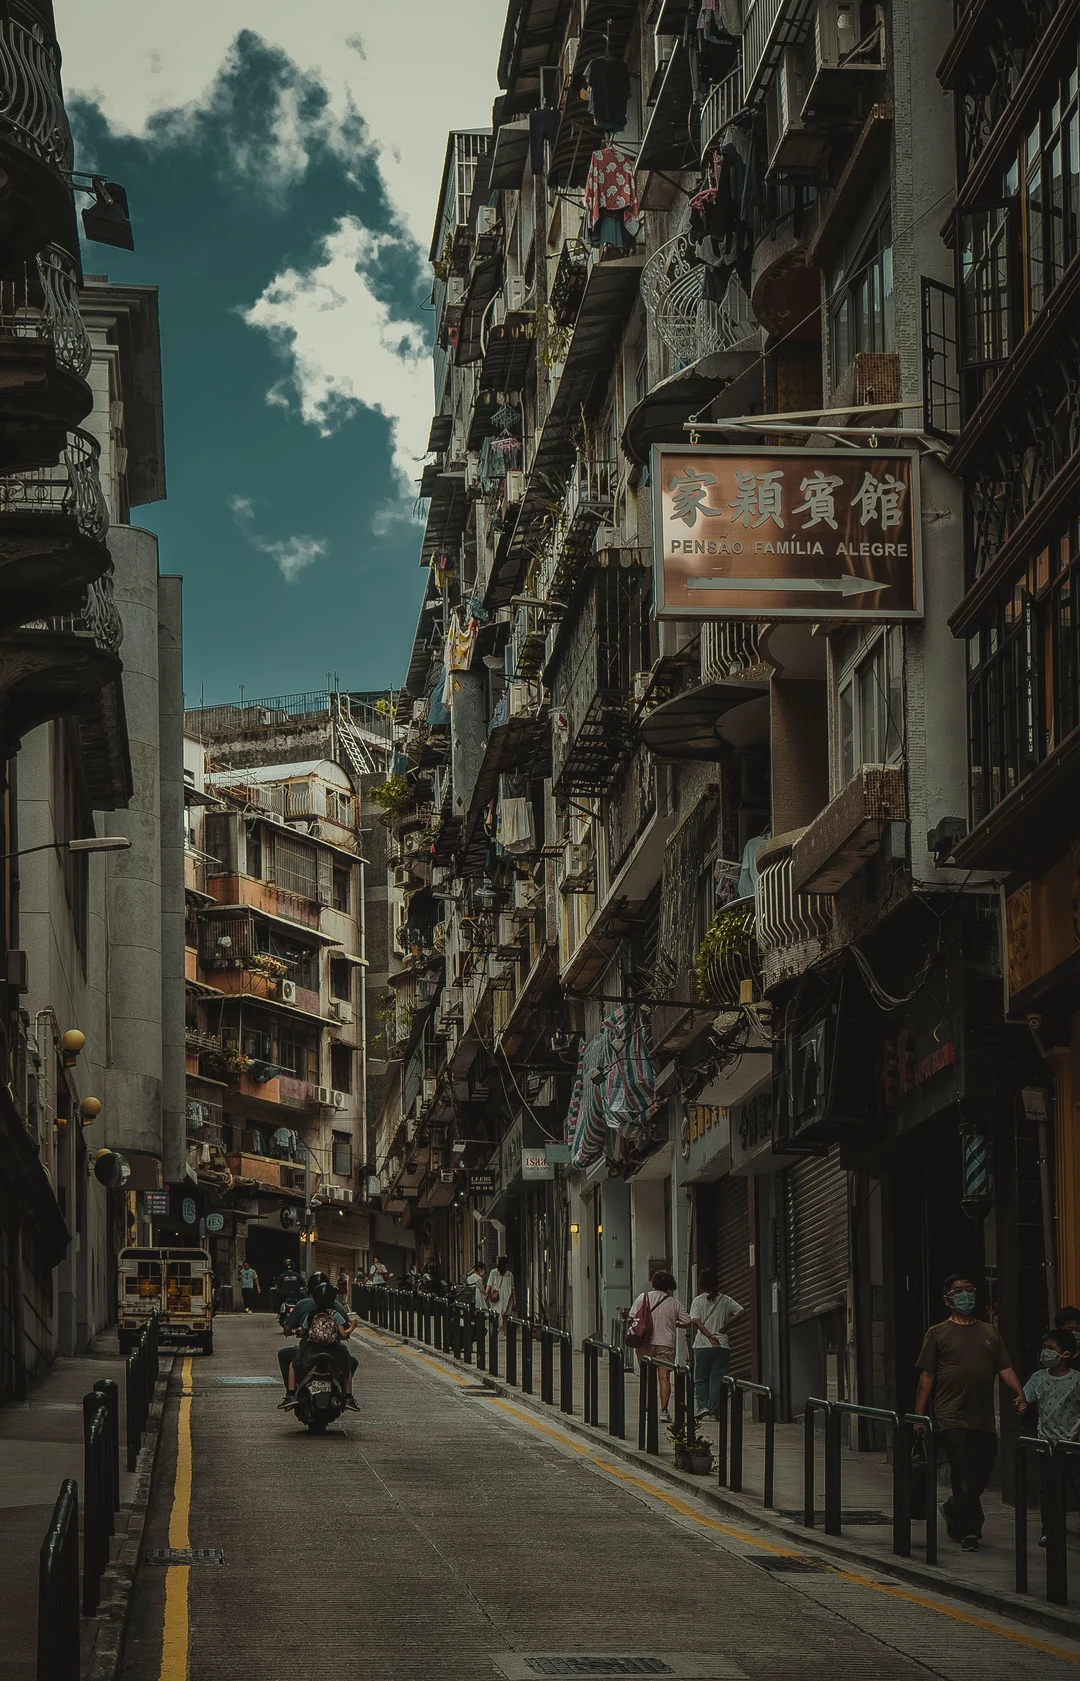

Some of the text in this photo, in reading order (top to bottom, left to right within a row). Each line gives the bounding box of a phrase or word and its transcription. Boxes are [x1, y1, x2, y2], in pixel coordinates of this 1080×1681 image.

[668, 467, 907, 532] 家穎賓館
[671, 533, 909, 558] PENSÃO FAMÍLIA ALEGRE
[207, 1218, 222, 1227] IES
